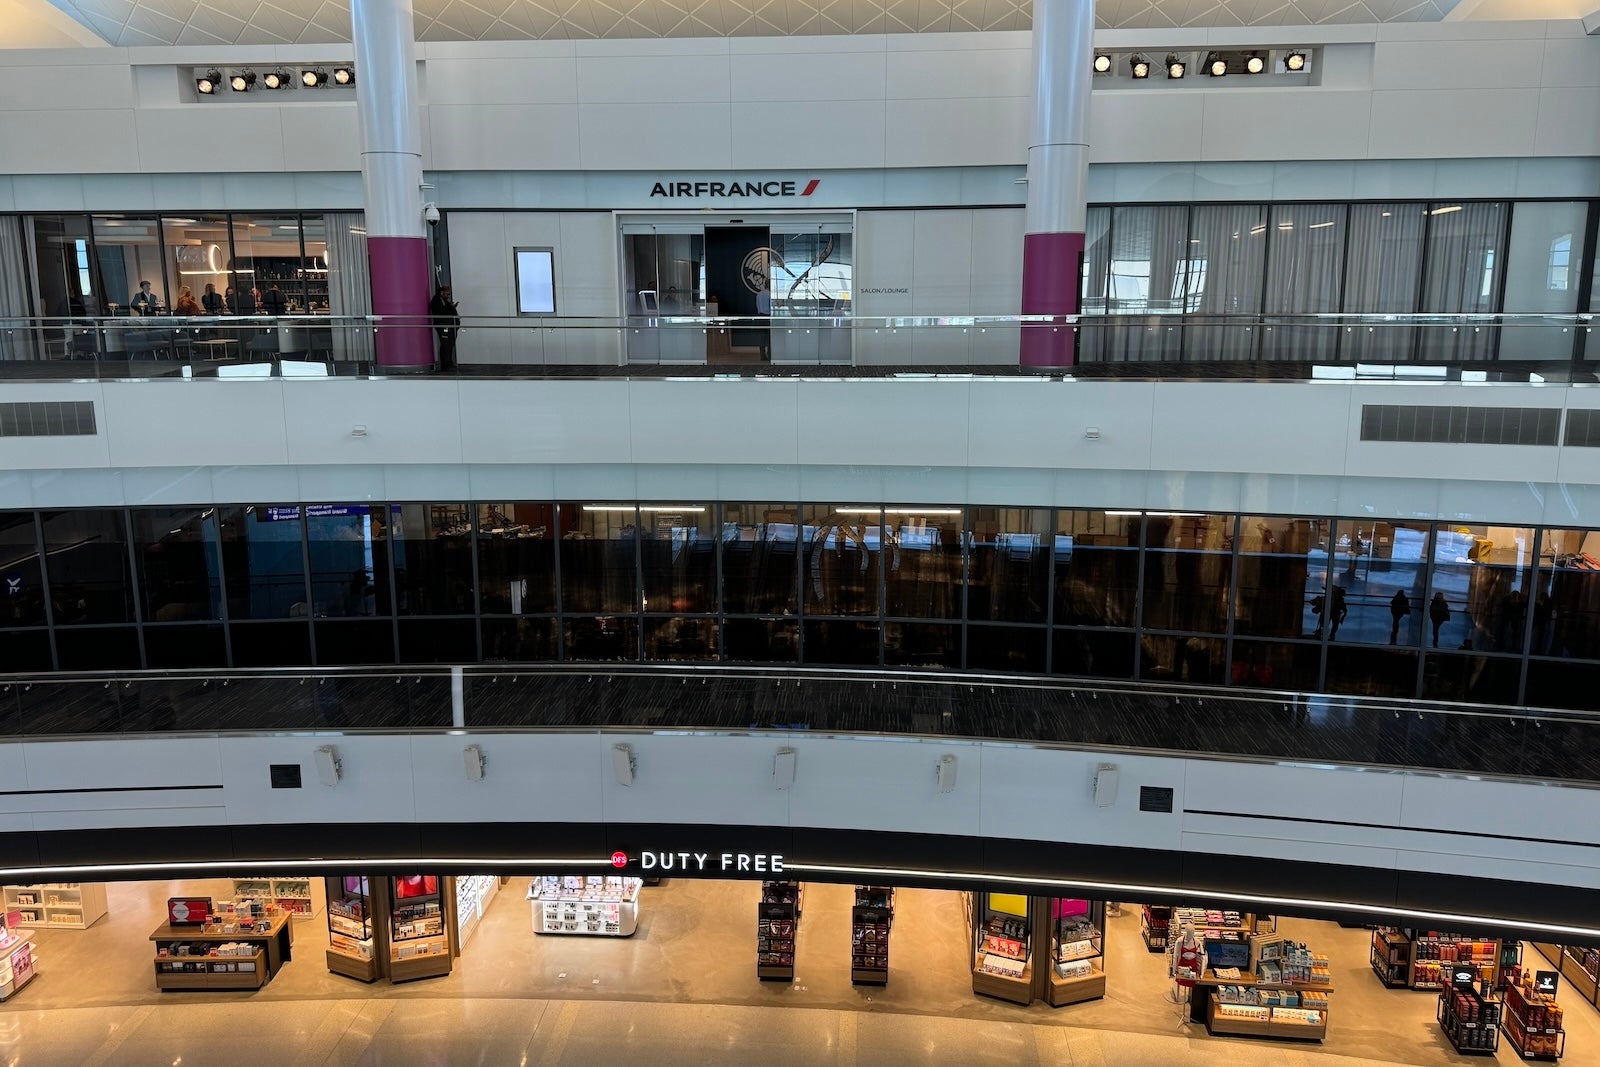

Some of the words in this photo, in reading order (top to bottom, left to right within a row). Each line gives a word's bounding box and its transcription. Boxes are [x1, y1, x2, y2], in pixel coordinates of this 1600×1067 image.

[650, 181, 796, 197] AIRFRANCE
[641, 851, 708, 870] DUTY
[721, 853, 784, 873] FREE
